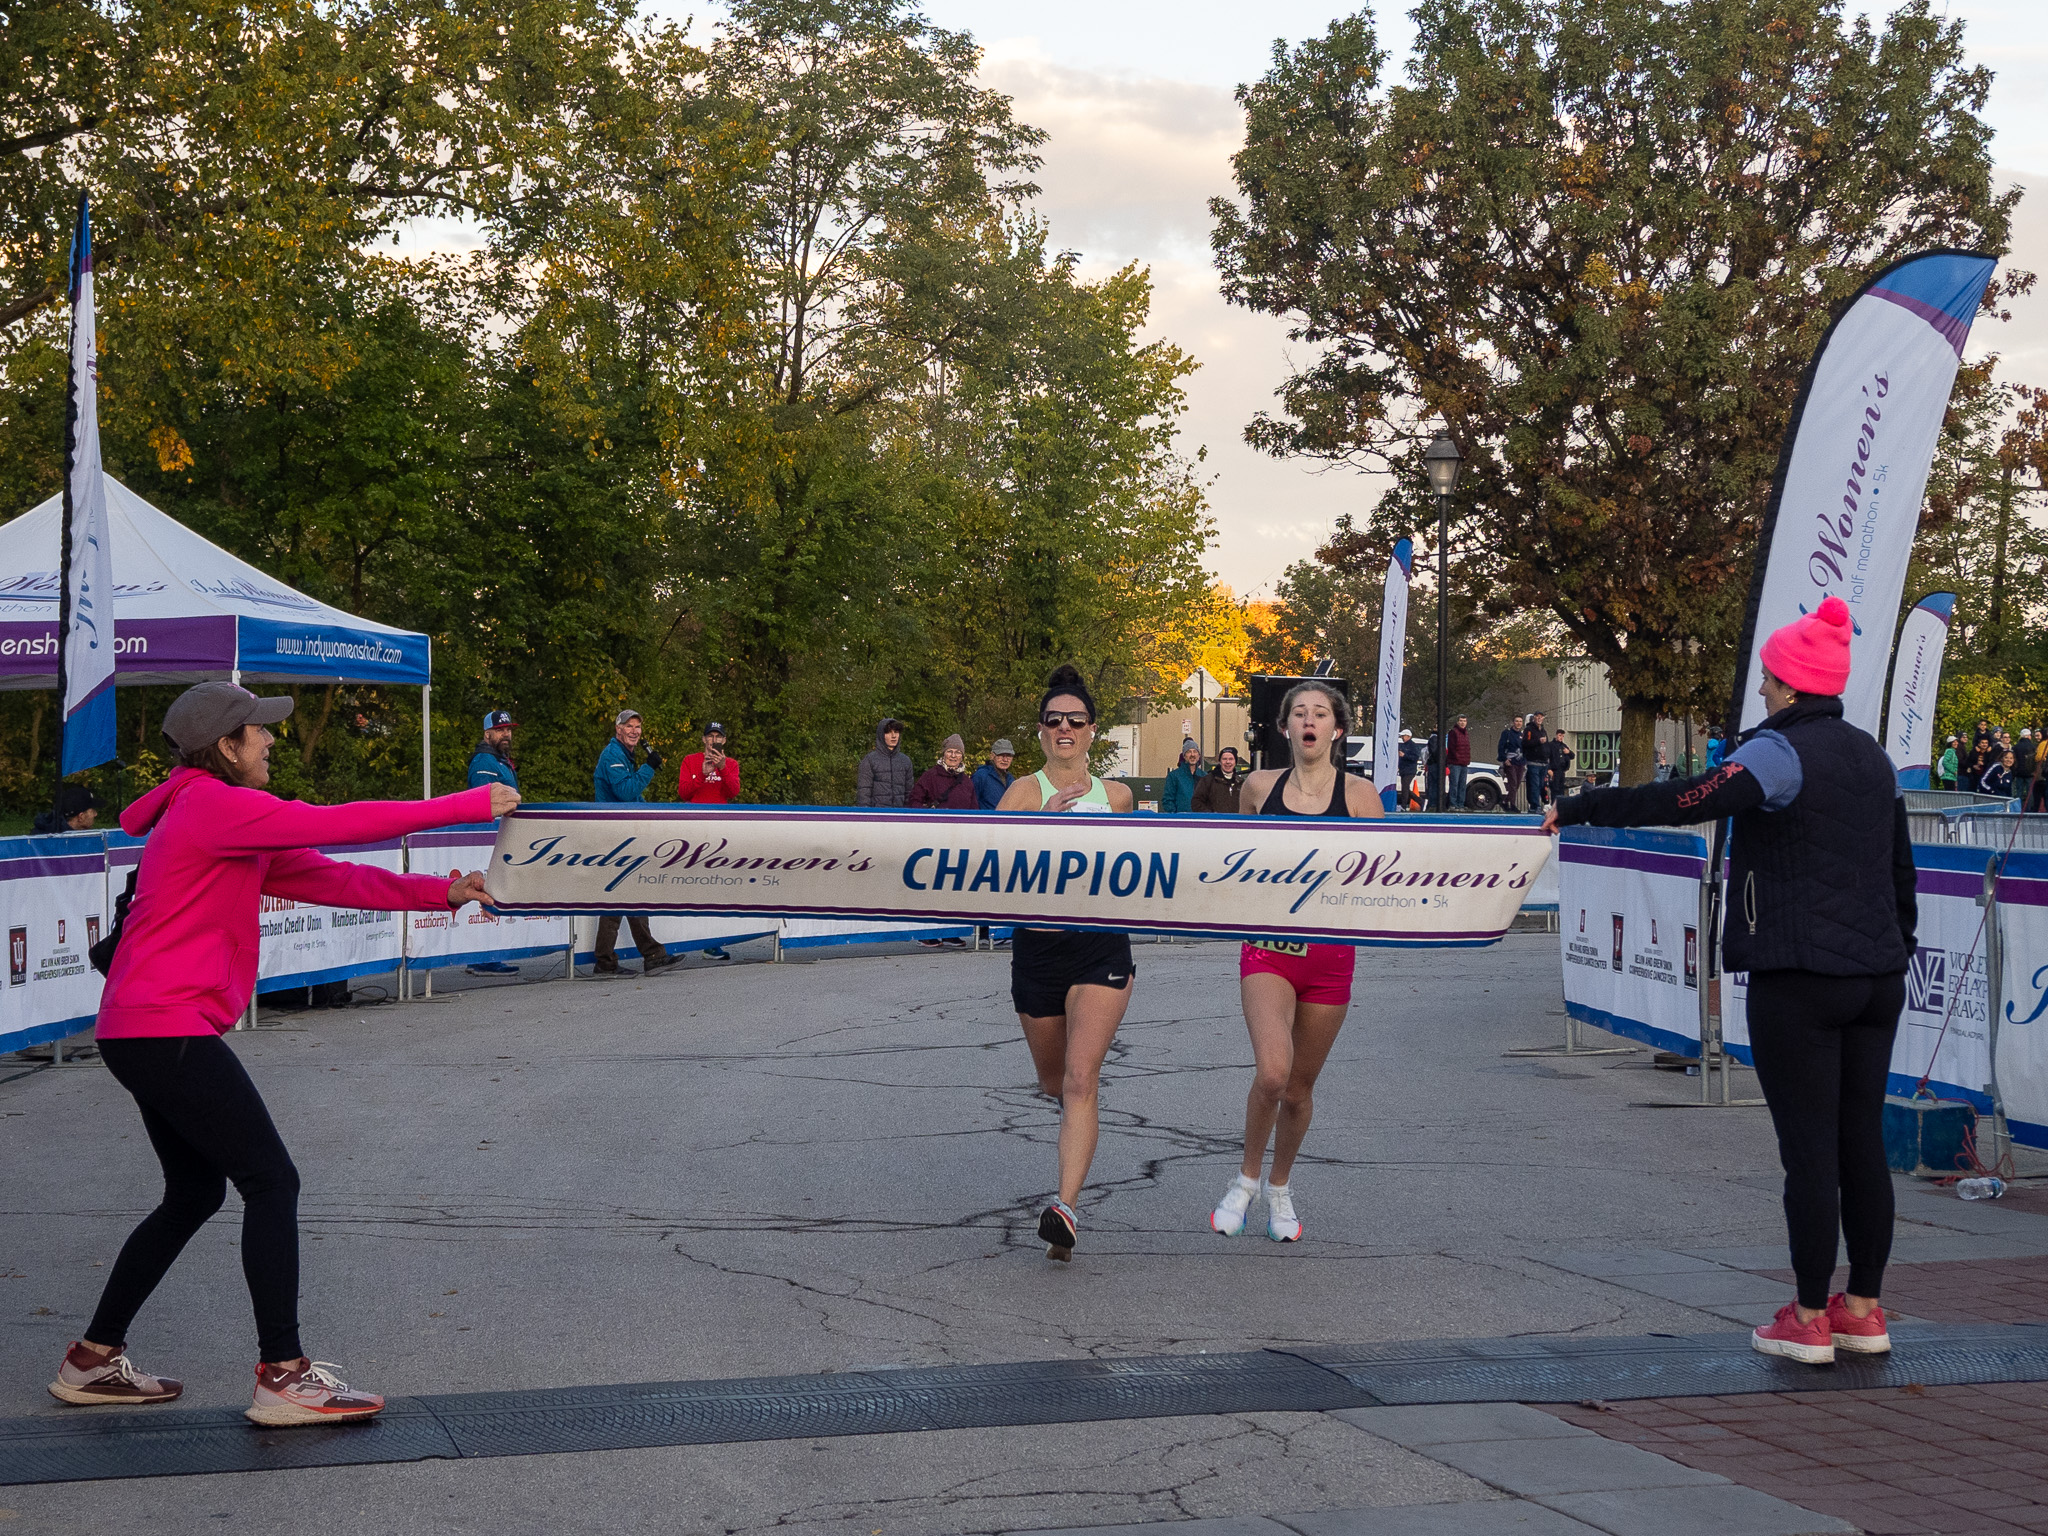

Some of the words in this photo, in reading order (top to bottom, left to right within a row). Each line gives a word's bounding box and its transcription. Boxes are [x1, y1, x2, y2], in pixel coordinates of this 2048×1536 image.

[1808, 370, 1889, 588] Women's
[1847, 574, 1865, 604] half
[1856, 501, 1880, 571] marathon
[1872, 464, 1889, 483] 5k
[637, 873, 668, 887] half
[670, 875, 743, 887] marathon
[761, 874, 781, 887] 5k
[902, 847, 1180, 899] CHAMPION
[1320, 892, 1349, 907] half
[1350, 893, 1417, 908] marathon
[1432, 894, 1449, 909] 5k
[414, 913, 449, 930] authority
